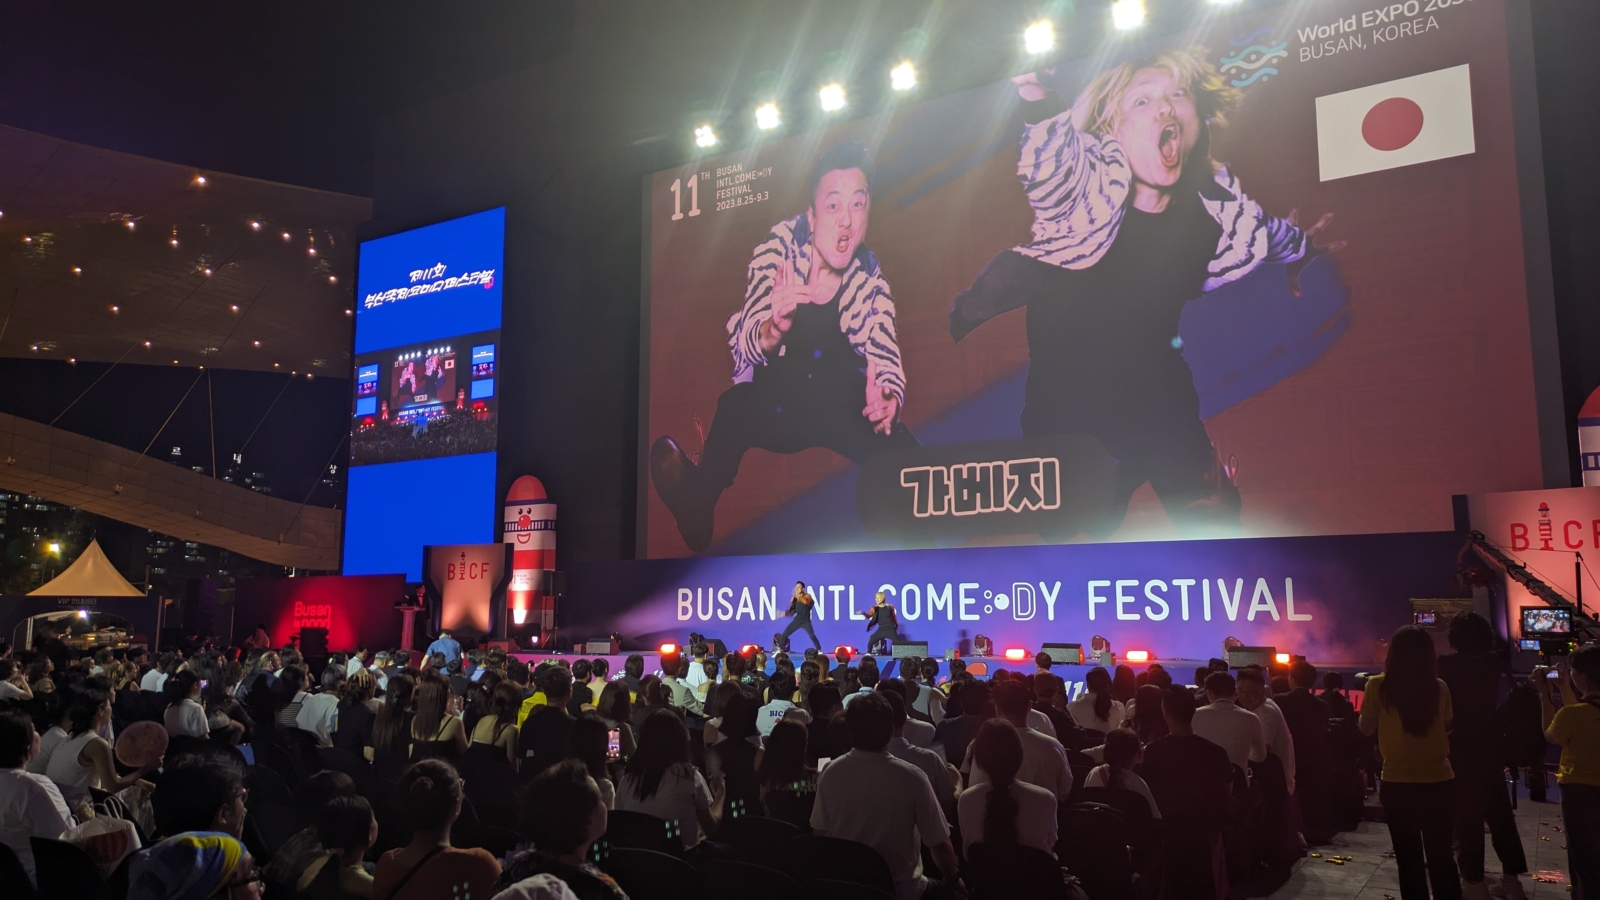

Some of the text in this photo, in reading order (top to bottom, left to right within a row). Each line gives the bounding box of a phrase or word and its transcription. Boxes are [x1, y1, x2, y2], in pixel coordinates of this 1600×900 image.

[1297, 0, 1472, 43] World EXPO 20
[1300, 16, 1439, 62] BUSAN, KOREA
[716, 163, 743, 177] BUSAN
[716, 184, 752, 199] FESTIVAL
[716, 191, 769, 211] 2023.8.25-9.3
[409, 262, 447, 282] 제11회
[901, 457, 1061, 517] 가베지
[294, 601, 332, 616] Busan
[677, 586, 777, 621] BUSAN
[1088, 577, 1313, 621] FESTIVAL
